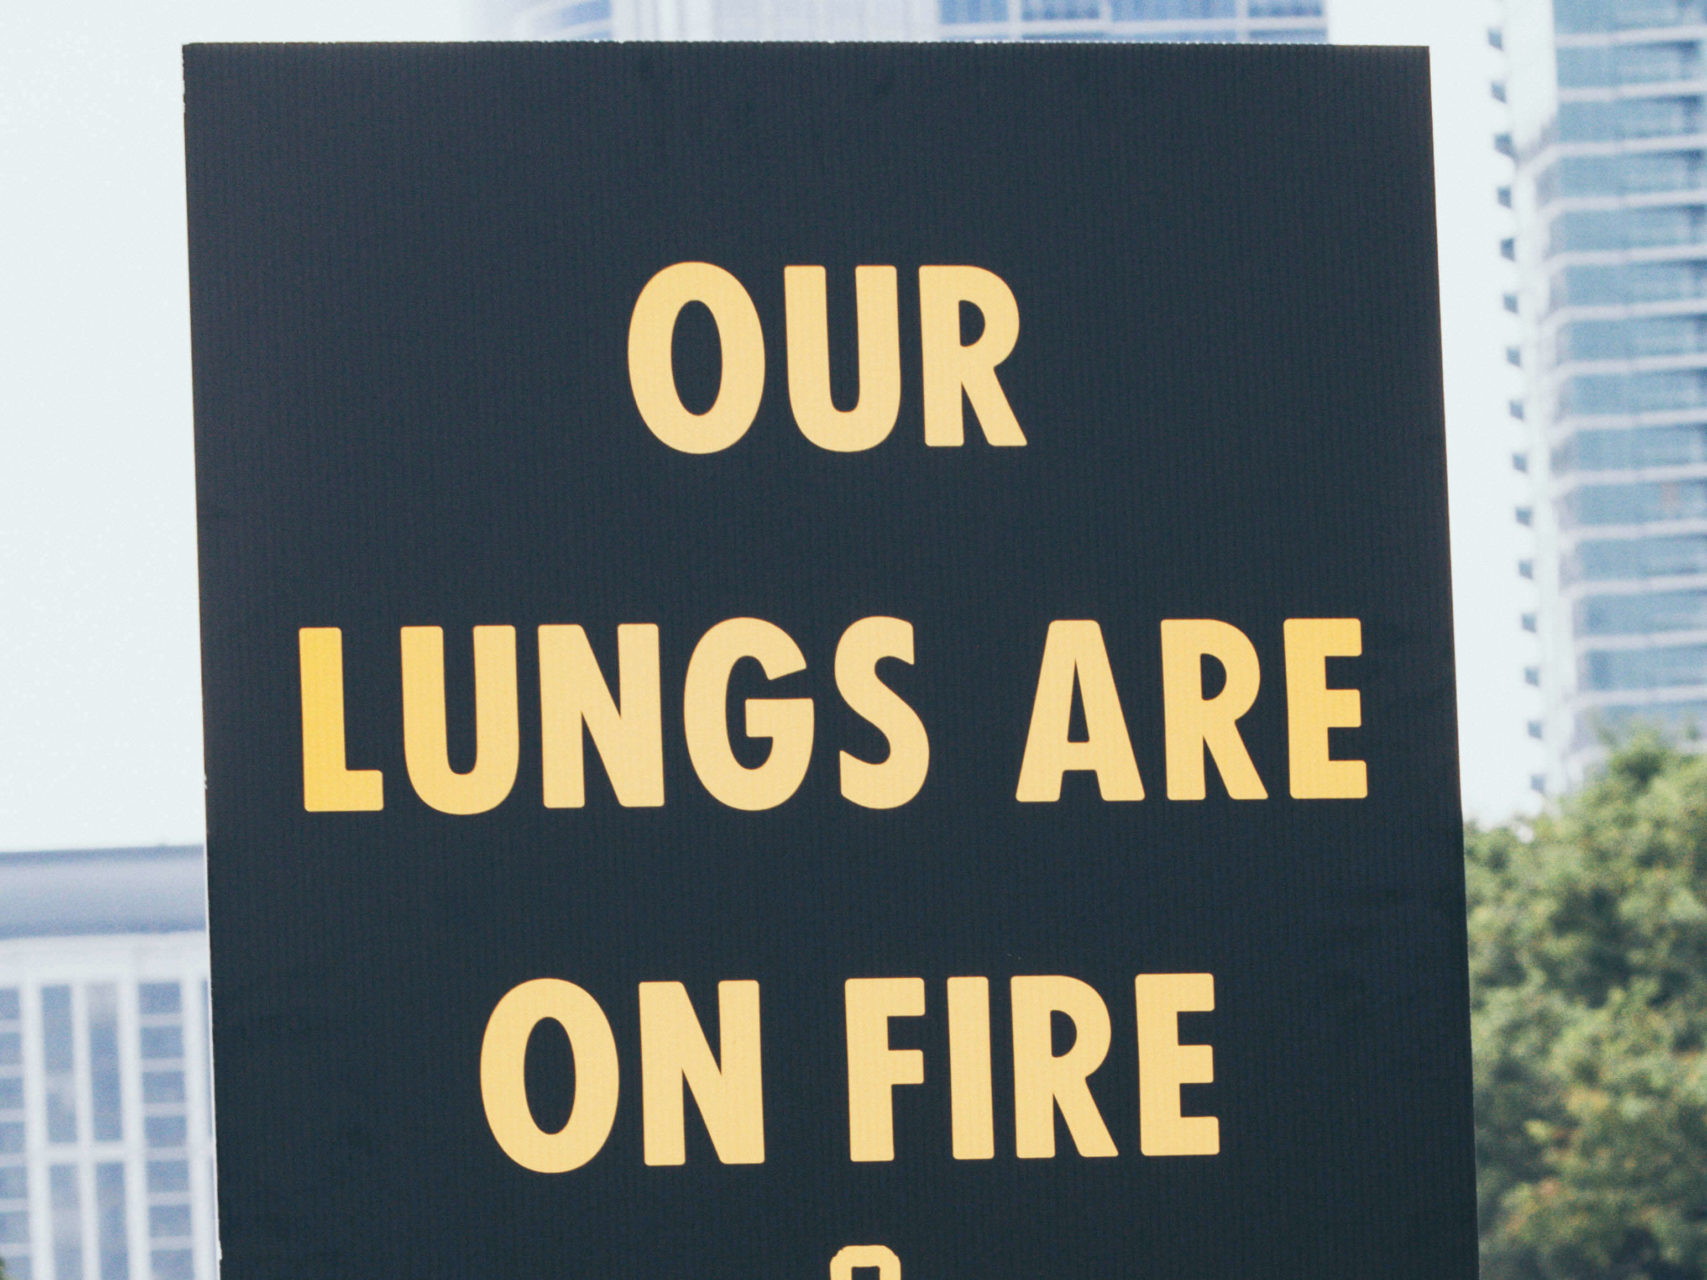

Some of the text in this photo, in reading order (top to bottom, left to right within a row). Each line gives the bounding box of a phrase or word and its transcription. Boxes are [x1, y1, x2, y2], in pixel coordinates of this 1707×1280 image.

[627, 260, 1028, 455] OUR
[298, 615, 1369, 813] LUNGS ARE
[479, 971, 1221, 1174] ON FIRE
